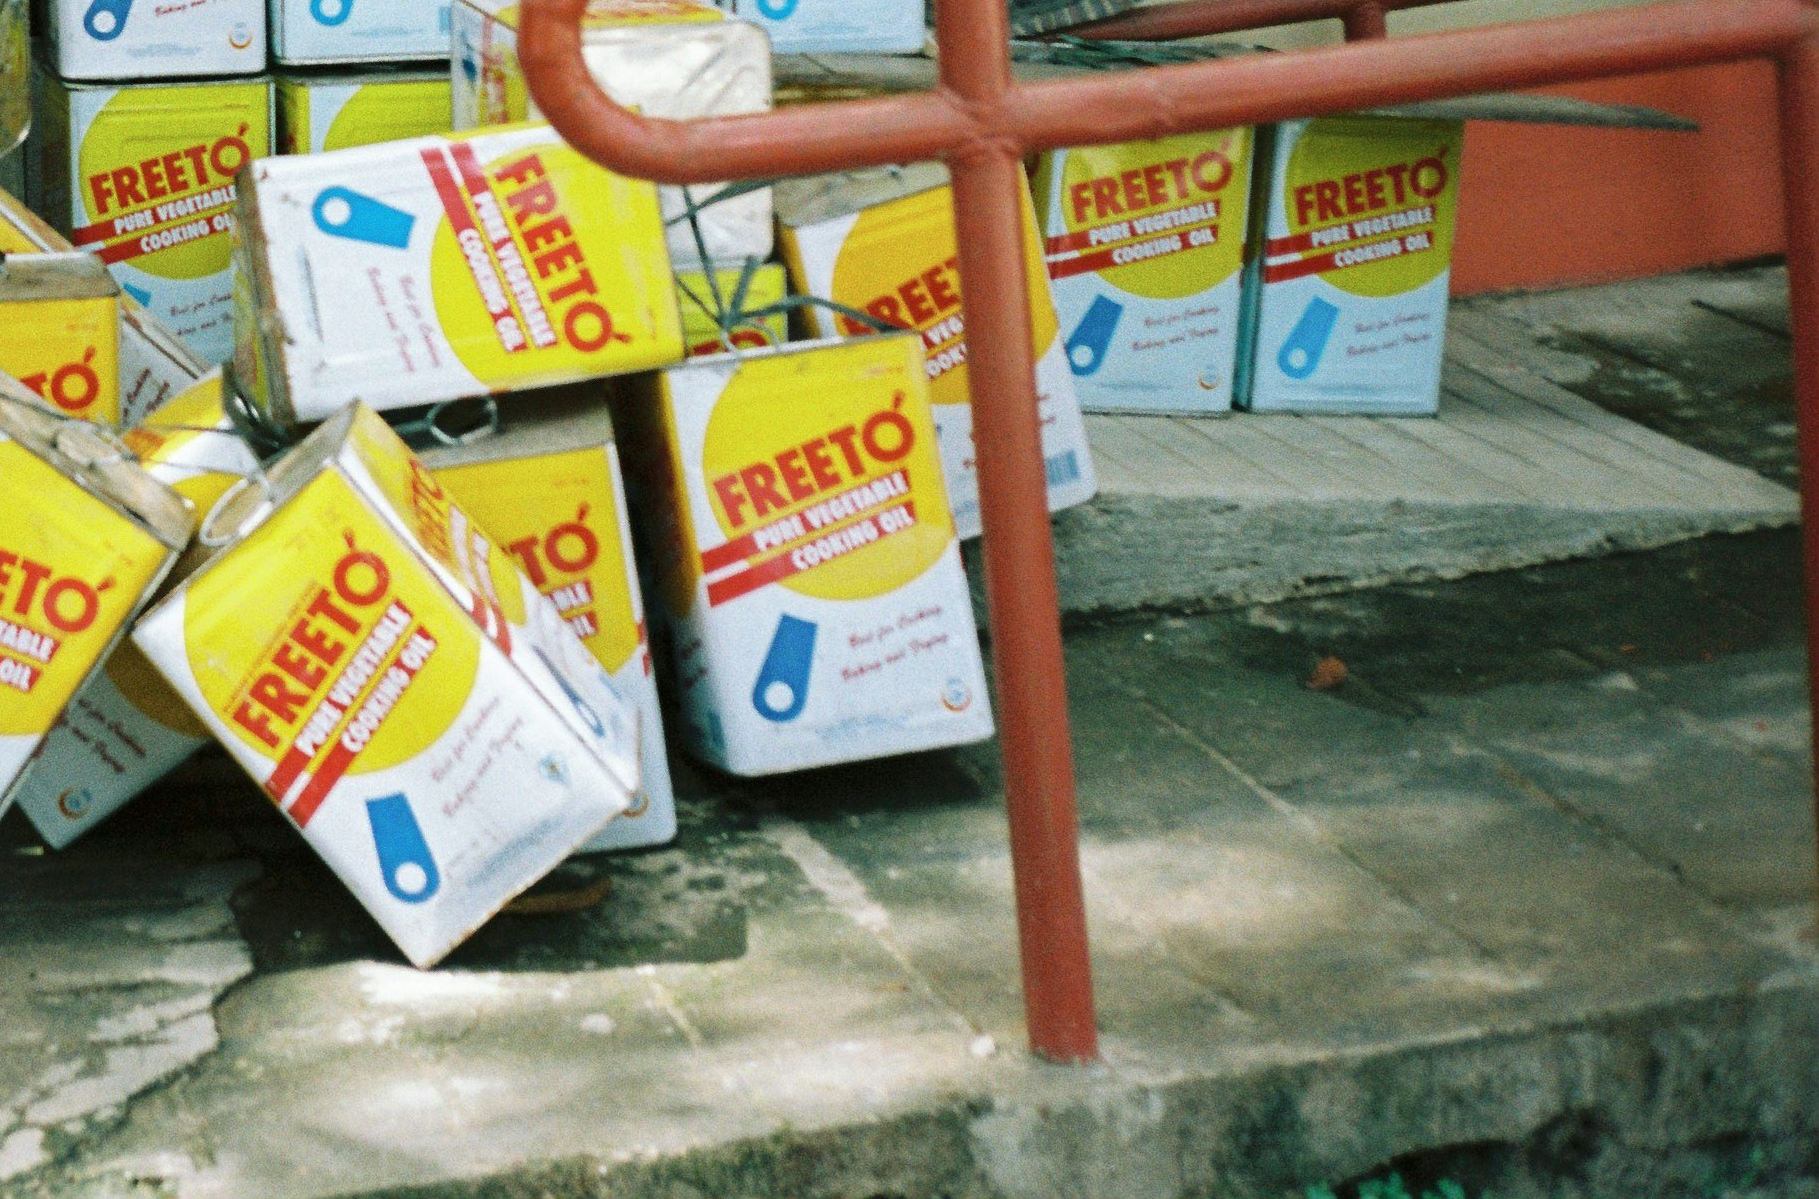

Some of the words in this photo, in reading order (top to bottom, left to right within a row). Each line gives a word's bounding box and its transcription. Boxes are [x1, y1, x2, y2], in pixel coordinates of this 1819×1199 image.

[90, 122, 250, 216] FREETO
[1070, 138, 1232, 223] FREETO
[1295, 145, 1450, 225] FREETO
[115, 210, 154, 235] PURE
[157, 185, 237, 220] VEGETABLE
[141, 220, 209, 252] COOKING
[1088, 224, 1130, 246] PURE
[1134, 202, 1217, 235] VEGETABLE
[1112, 235, 1181, 265] COOKING
[1189, 226, 1217, 246] OIL
[1311, 226, 1350, 248] PURE
[1354, 205, 1434, 238] VEGETABLE
[1334, 239, 1403, 267] COOKING
[1406, 232, 1430, 251] OIL
[494, 153, 631, 352] FREETO
[712, 390, 915, 528] FREETO
[753, 514, 805, 553] PURE
[807, 471, 909, 529] VEGETABLE
[791, 522, 879, 571] COOKING
[881, 504, 915, 532] OIL
[232, 527, 390, 750] FREETO
[294, 698, 342, 757] PURE
[328, 602, 412, 706] VEGETABLE
[341, 666, 410, 752] COOKING
[400, 632, 438, 670] OIL
